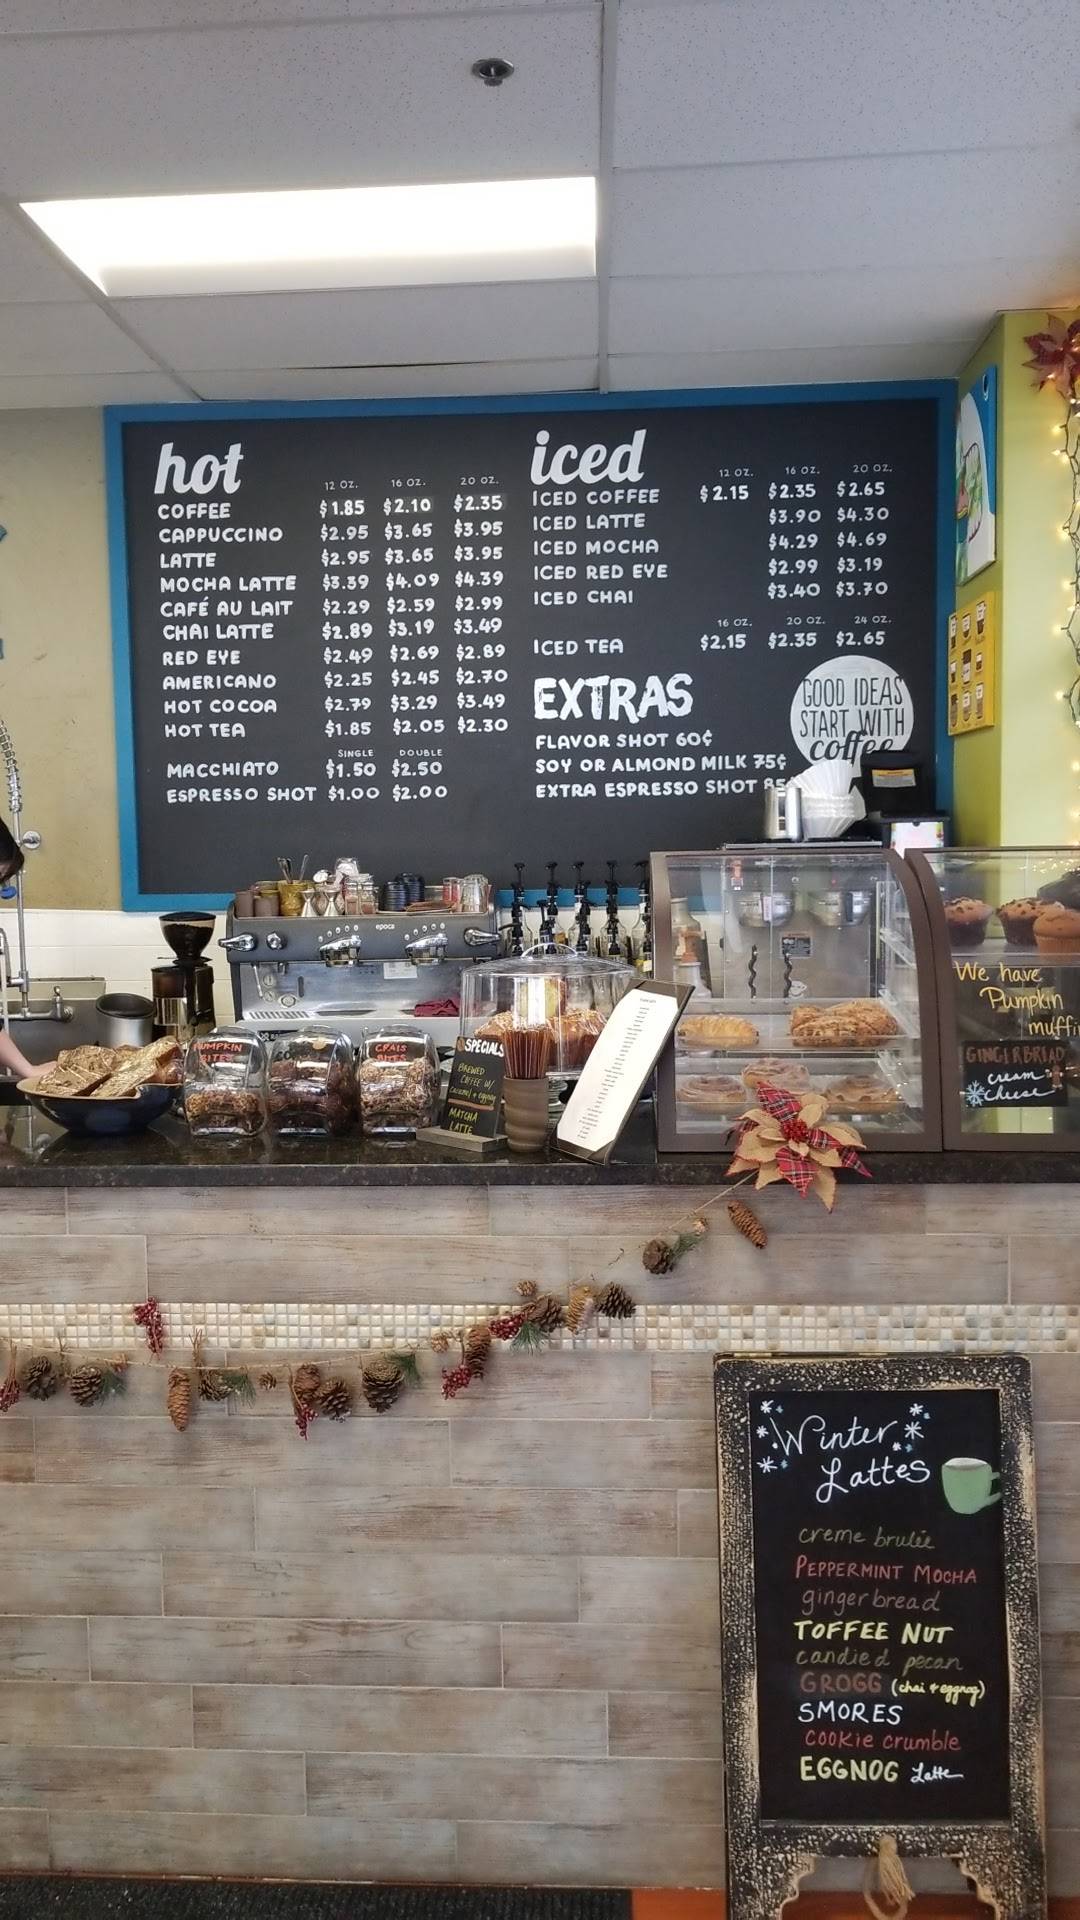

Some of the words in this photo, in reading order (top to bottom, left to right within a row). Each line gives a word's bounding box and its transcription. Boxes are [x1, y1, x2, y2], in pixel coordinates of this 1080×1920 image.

[531, 429, 646, 485] iced
[154, 443, 243, 494] hot
[720, 469, 729, 477] 12
[735, 469, 753, 477] OZ.
[801, 466, 820, 474] OZ.
[853, 464, 868, 473] 20
[873, 464, 892, 472] OZ.
[325, 481, 335, 490] 12
[340, 480, 358, 489] OZ.
[392, 479, 402, 487] 16
[461, 477, 475, 485] 20
[481, 476, 498, 484] OZ.
[533, 491, 576, 506] ICED
[587, 489, 659, 504] COFFEE
[700, 485, 748, 502] $2.15
[769, 483, 816, 499] $2.35
[837, 481, 884, 497] $2.65
[158, 503, 230, 519] COFFEE
[320, 500, 364, 518] $1.85
[384, 498, 431, 515] $2.10
[454, 494, 502, 512] $2.35
[534, 516, 576, 531] ICED
[587, 513, 645, 529] LATTE
[769, 509, 821, 525] $3.90
[837, 507, 889, 522] $4.30
[159, 527, 282, 543] CAPPUCCINO
[321, 524, 368, 541] $2.95
[385, 522, 432, 540] $3.65
[454, 519, 503, 537] $3.95
[534, 541, 577, 555] ICED
[586, 539, 658, 555] MOCHA
[769, 533, 818, 550] $4.29
[837, 532, 886, 547] $4.69
[161, 553, 216, 568] LATTE
[322, 549, 370, 567] $2.95
[385, 548, 433, 565] $3.65
[454, 545, 502, 561] $3.95
[534, 565, 576, 580] ICED
[587, 565, 623, 579] RED
[633, 564, 667, 578] EYE
[769, 558, 818, 576] $2.99
[837, 557, 882, 573] $3.19
[161, 576, 231, 592] MOCHA
[239, 575, 296, 591] LATTE
[323, 574, 369, 591] $3.39
[386, 573, 439, 591] $4.09
[455, 571, 503, 587] $4.39
[534, 591, 577, 605] ICED
[587, 590, 633, 603] CHAI
[768, 582, 820, 599] $3.40
[836, 581, 888, 597] $3.70
[161, 596, 208, 617] CAFÉ
[217, 601, 242, 616] AU
[251, 601, 293, 616] LAIT
[323, 599, 370, 616] $2.29
[387, 597, 434, 614] $2.59
[455, 595, 502, 611] $2.99
[163, 624, 208, 641] CHAI
[216, 623, 273, 639] LATTE
[322, 622, 372, 640] $2.89
[389, 619, 434, 637] $3.19
[454, 618, 502, 634] $3.49
[718, 619, 729, 627] 16
[787, 617, 801, 625] 20
[807, 616, 825, 624] OZ.
[855, 616, 867, 624] 24
[534, 640, 578, 655] ICED
[585, 639, 623, 653] TEA
[701, 634, 746, 651] $2.15
[768, 632, 816, 649] $2.35
[836, 631, 885, 647] $2.65
[163, 651, 198, 665] RED
[207, 650, 240, 665] EYE
[324, 647, 372, 664] $2.49
[390, 645, 439, 662] $2.69
[457, 644, 505, 661] $2.89
[163, 674, 276, 690] AMERICANO
[325, 671, 372, 688] $2.25
[392, 669, 439, 687] $2.45
[456, 667, 508, 685] $2.70
[534, 673, 693, 724] EXTRAS
[802, 677, 845, 707] GOOD
[854, 676, 903, 705] IDEAS
[165, 700, 202, 714] HOT
[210, 699, 276, 713] COCOA
[325, 696, 371, 712] $2.79
[391, 694, 437, 712] $3.29
[457, 692, 505, 709] $3.49
[165, 724, 202, 737] HOT
[209, 723, 245, 737] TEA
[325, 720, 371, 737] $1.85
[393, 718, 444, 735] $2.05
[458, 716, 508, 733] $2.30
[800, 710, 850, 738] START
[858, 708, 905, 737] WITH
[536, 735, 610, 749] FLAVOR
[616, 733, 668, 747] SHOT
[676, 730, 712, 746] 60¢
[809, 730, 895, 767] coffee
[338, 749, 373, 757] SINGLE
[536, 759, 571, 773] SOY
[580, 759, 606, 771] OR
[612, 757, 695, 772] ALMOND
[702, 755, 746, 770] MILK
[753, 754, 786, 770] 75¢
[167, 761, 278, 778] MACCHIATO
[326, 759, 376, 779] $1.50
[392, 759, 442, 777] $2.50
[167, 788, 258, 803] ESPRESSO
[268, 787, 316, 801] SHOT
[328, 786, 379, 801] $1.00
[393, 784, 447, 801] $2.00
[536, 783, 596, 798] EXTRA
[605, 781, 698, 797] ESPRESSO
[706, 780, 757, 794] SHOT
[376, 923, 395, 931] epoca
[955, 961, 989, 981] We
[1000, 962, 1043, 982] have
[980, 987, 1064, 1016] Pumpkin
[465, 1039, 504, 1057] SPECIALS
[458, 1063, 485, 1075] BREWED
[448, 1108, 478, 1123] MATCHA
[769, 1414, 898, 1455] Winter
[795, 1555, 903, 1580] PEPPERMINT
[913, 1565, 977, 1585] MOCHA
[793, 1620, 889, 1641] TOFFEE
[901, 1622, 953, 1644] NUT
[903, 1655, 964, 1674] pecan
[800, 1673, 882, 1694] GROGG
[798, 1702, 903, 1725] SMORES
[882, 1730, 961, 1752] crumble
[800, 1755, 899, 1783] EGGNOG
